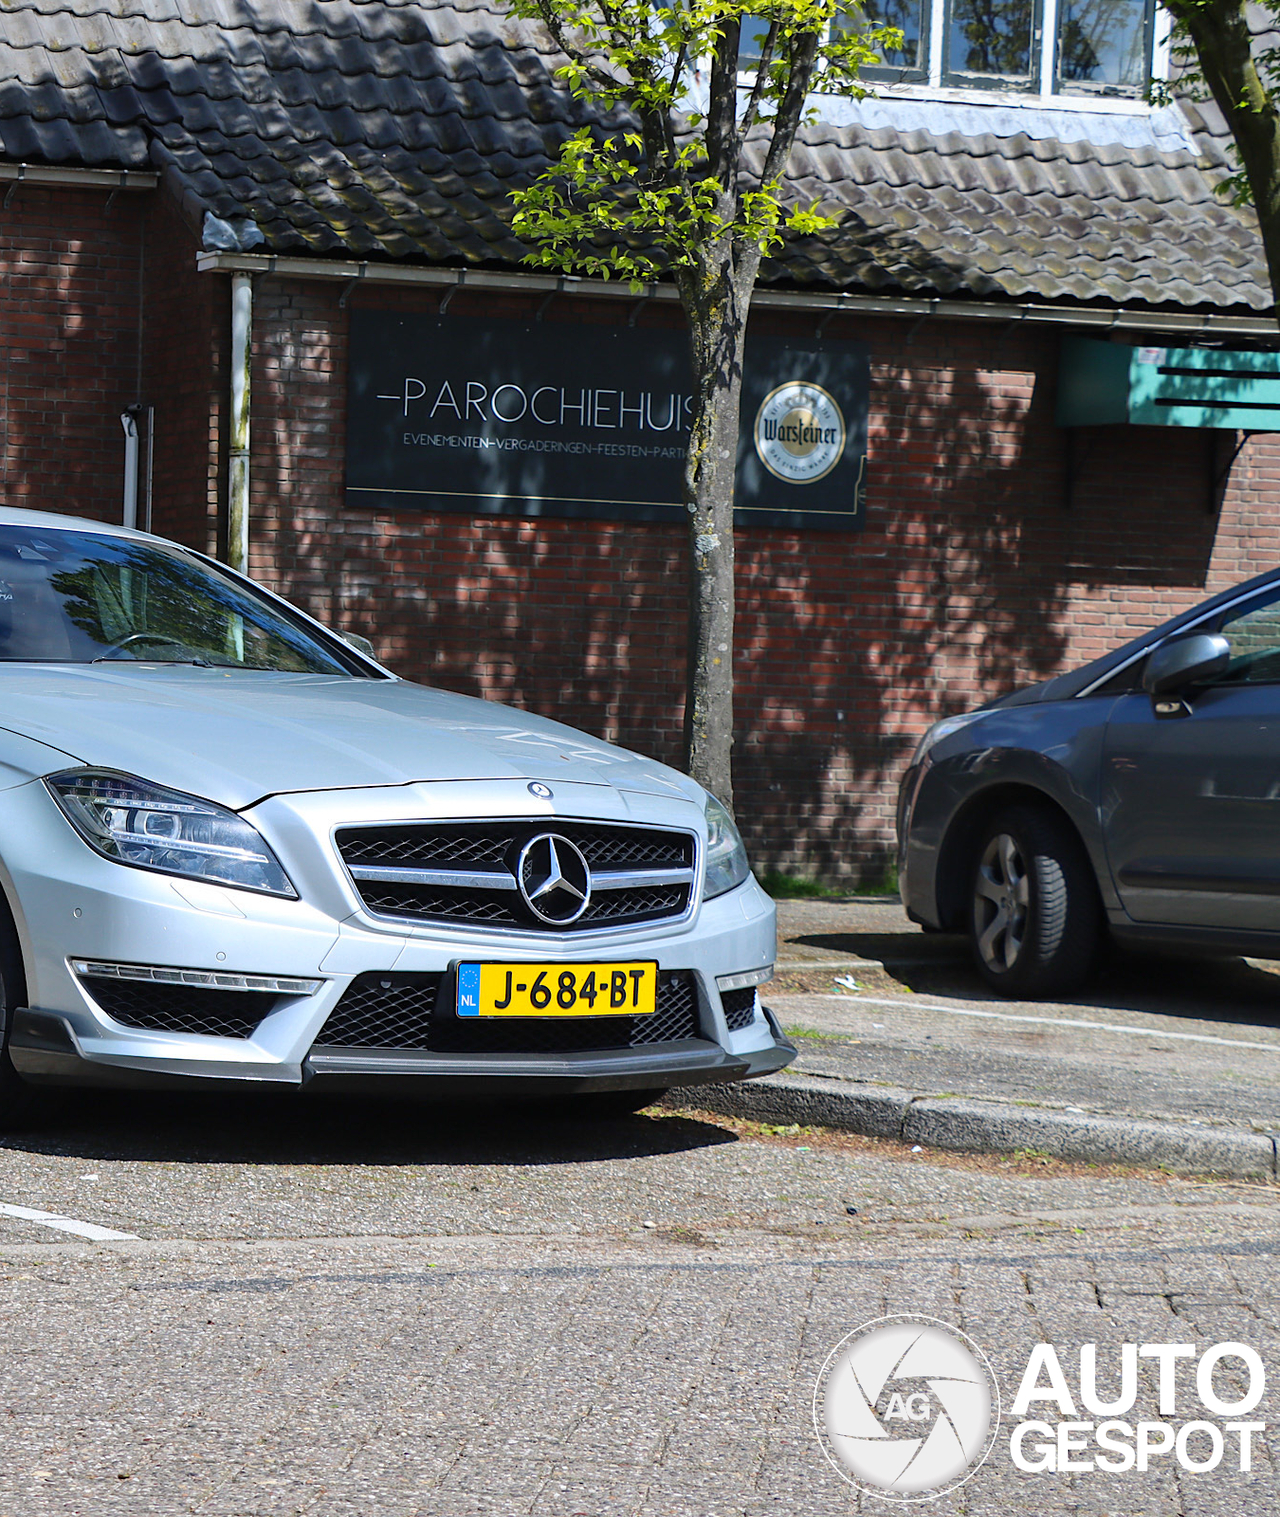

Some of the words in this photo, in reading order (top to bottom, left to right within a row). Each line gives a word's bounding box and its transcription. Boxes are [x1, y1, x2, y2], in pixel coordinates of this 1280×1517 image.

[763, 418, 837, 446] Warsteiner
[460, 994, 477, 1007] NL
[494, 970, 646, 1010] J-684-BT
